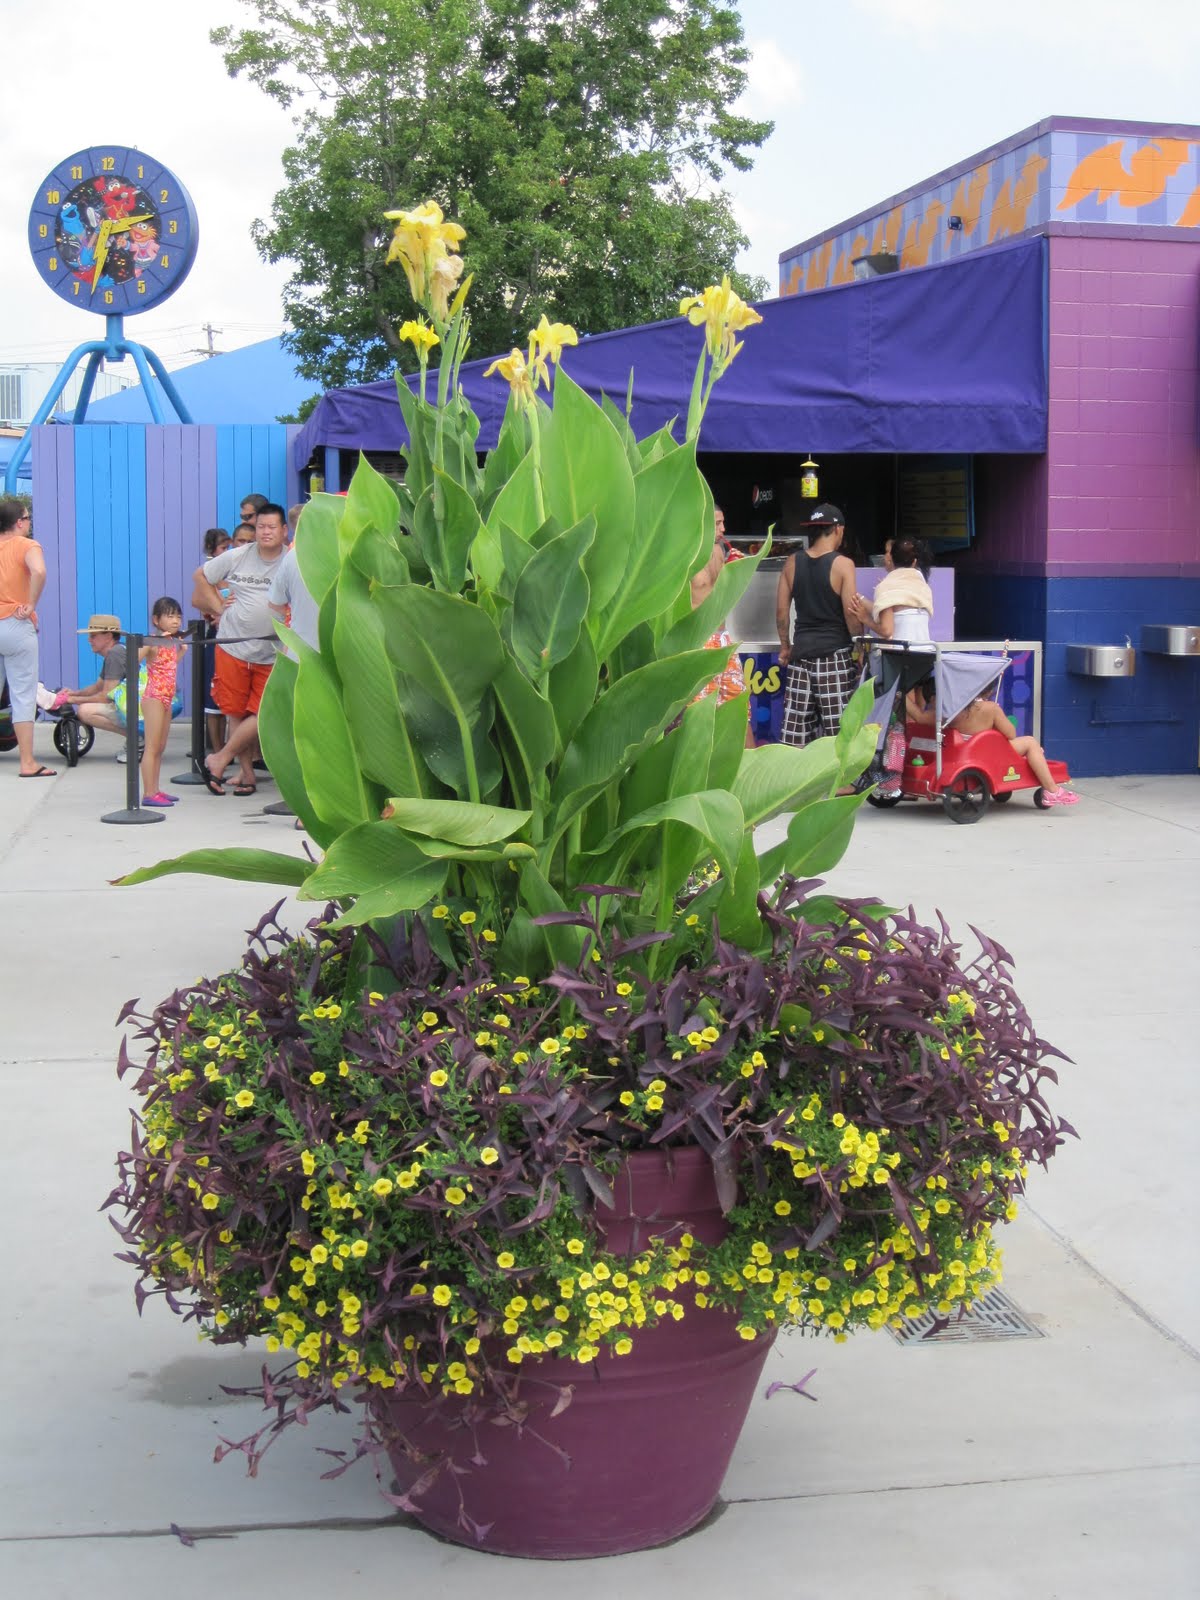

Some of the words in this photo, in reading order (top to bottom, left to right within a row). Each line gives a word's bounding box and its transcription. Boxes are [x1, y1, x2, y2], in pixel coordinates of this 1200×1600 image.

[102, 157, 115, 170] 12
[71, 166, 83, 180] 11
[137, 166, 144, 179] 1
[46, 191, 60, 205] 10
[160, 190, 169, 203] 2
[39, 224, 48, 238] 9
[169, 220, 178, 234] 3
[49, 258, 58, 271] 8
[160, 255, 169, 268] 4
[73, 282, 80, 295] 7
[138, 280, 146, 294] 5
[104, 291, 113, 304] 6
